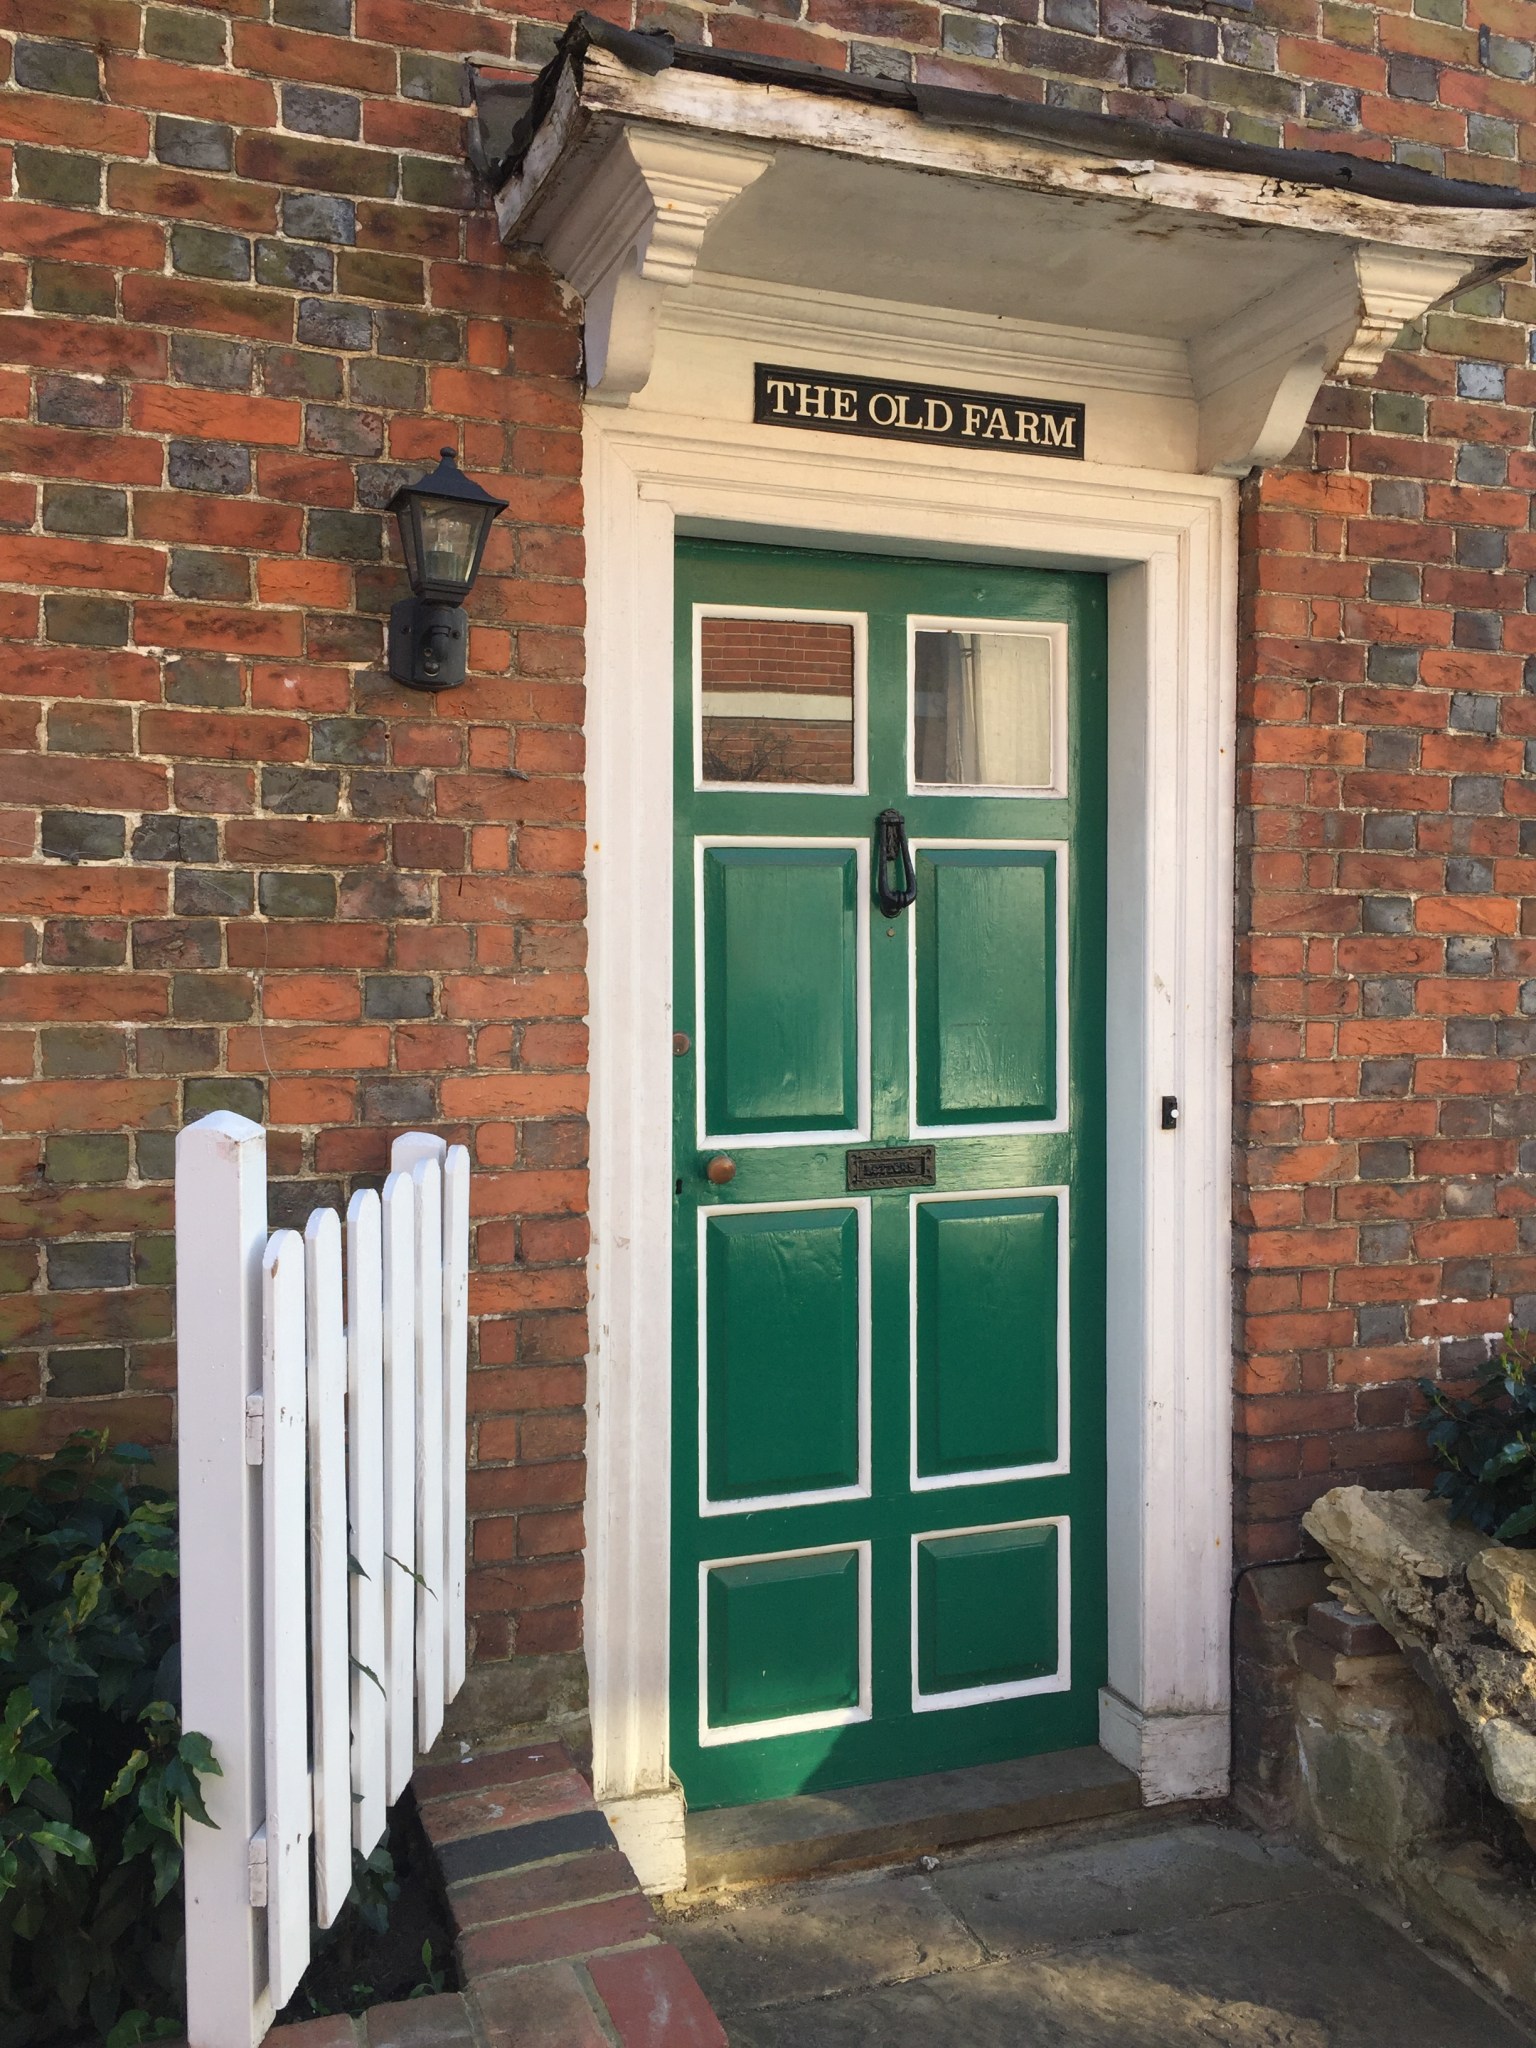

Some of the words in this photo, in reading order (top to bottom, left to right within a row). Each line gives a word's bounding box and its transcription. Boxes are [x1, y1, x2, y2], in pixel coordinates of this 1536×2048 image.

[767, 380, 857, 421] THE
[868, 393, 953, 432] OLD
[961, 403, 1076, 448] FARM
